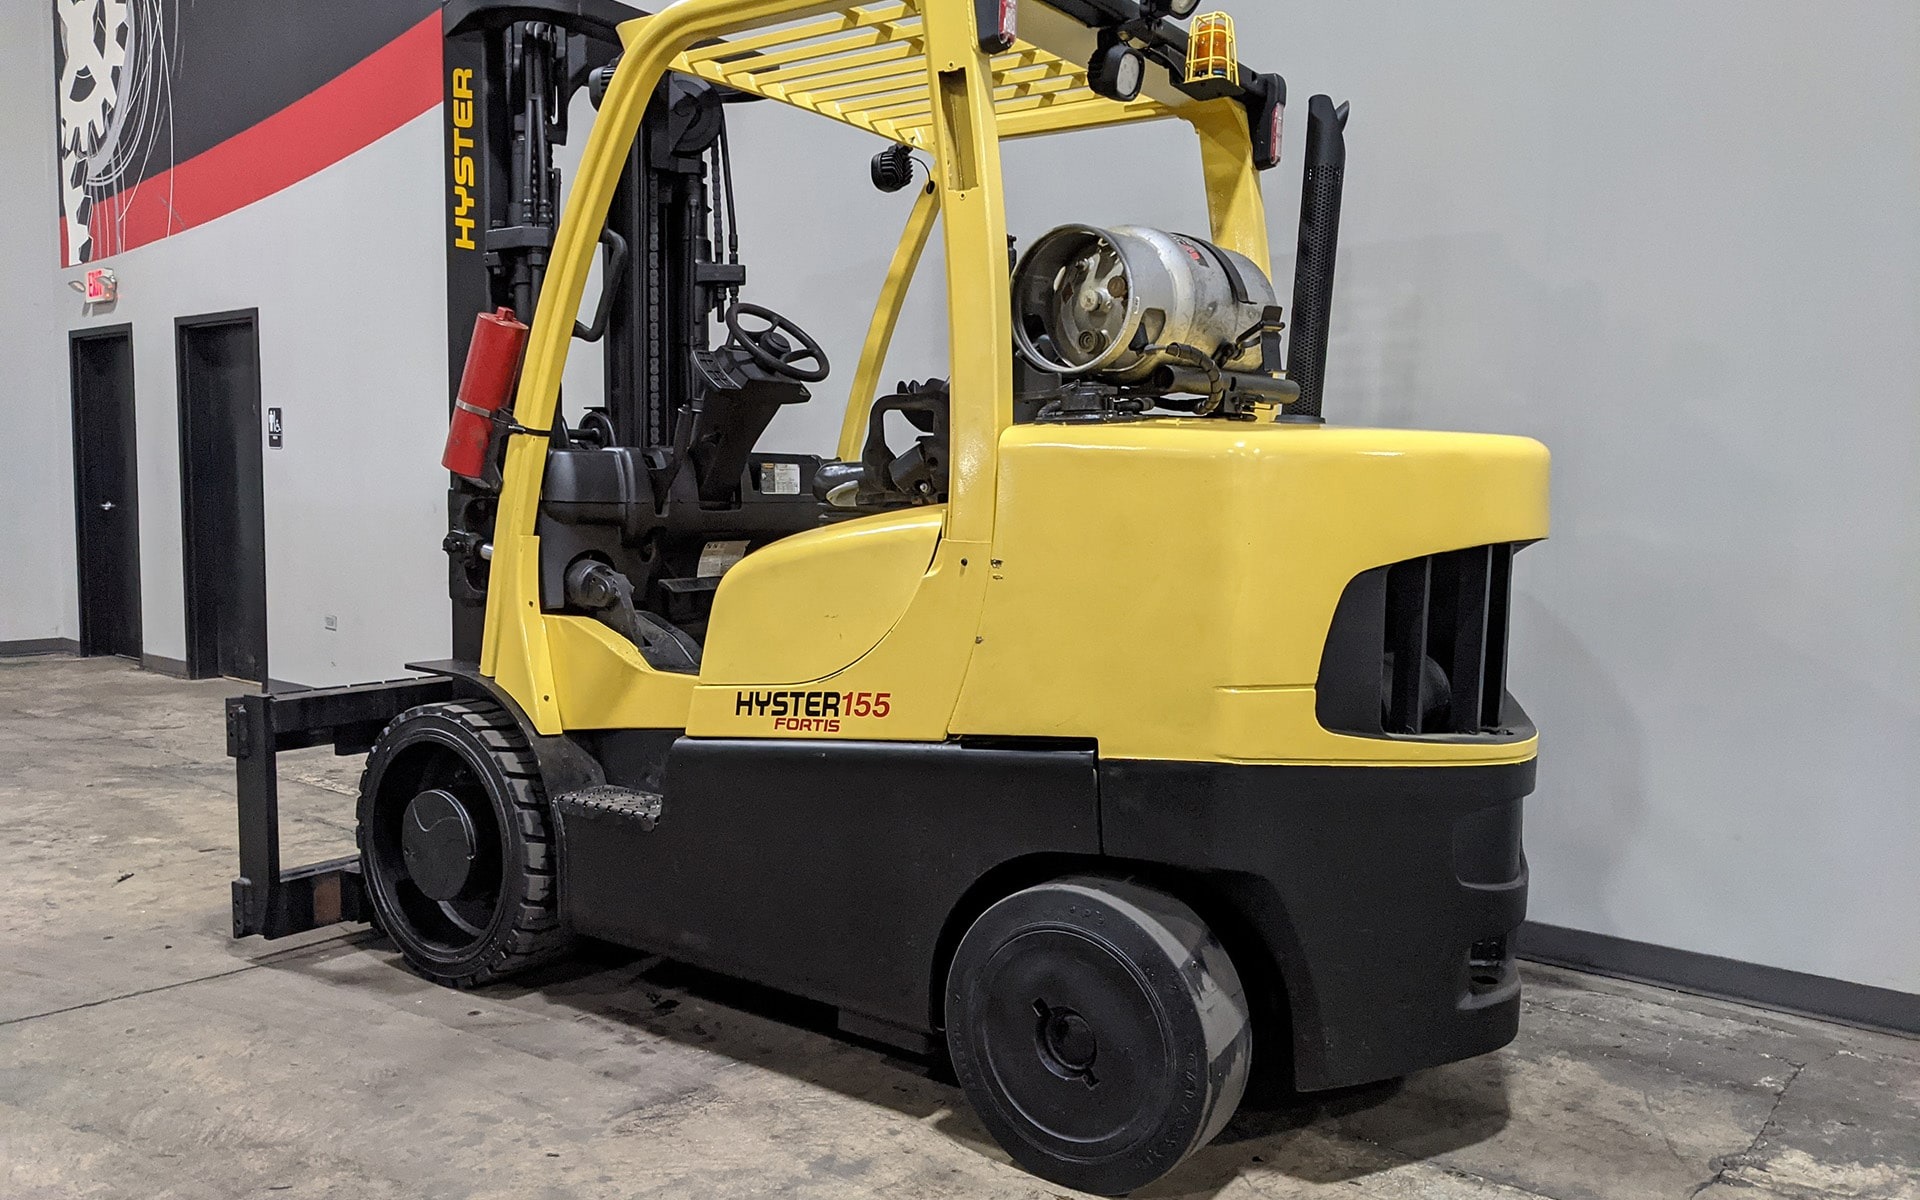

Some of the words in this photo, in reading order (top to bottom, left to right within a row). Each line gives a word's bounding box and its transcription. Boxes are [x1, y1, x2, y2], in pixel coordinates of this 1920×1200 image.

[453, 67, 475, 250] HYSTER
[735, 691, 841, 717] HYSTER
[842, 691, 891, 718] 155
[774, 717, 841, 733] FORTIS
